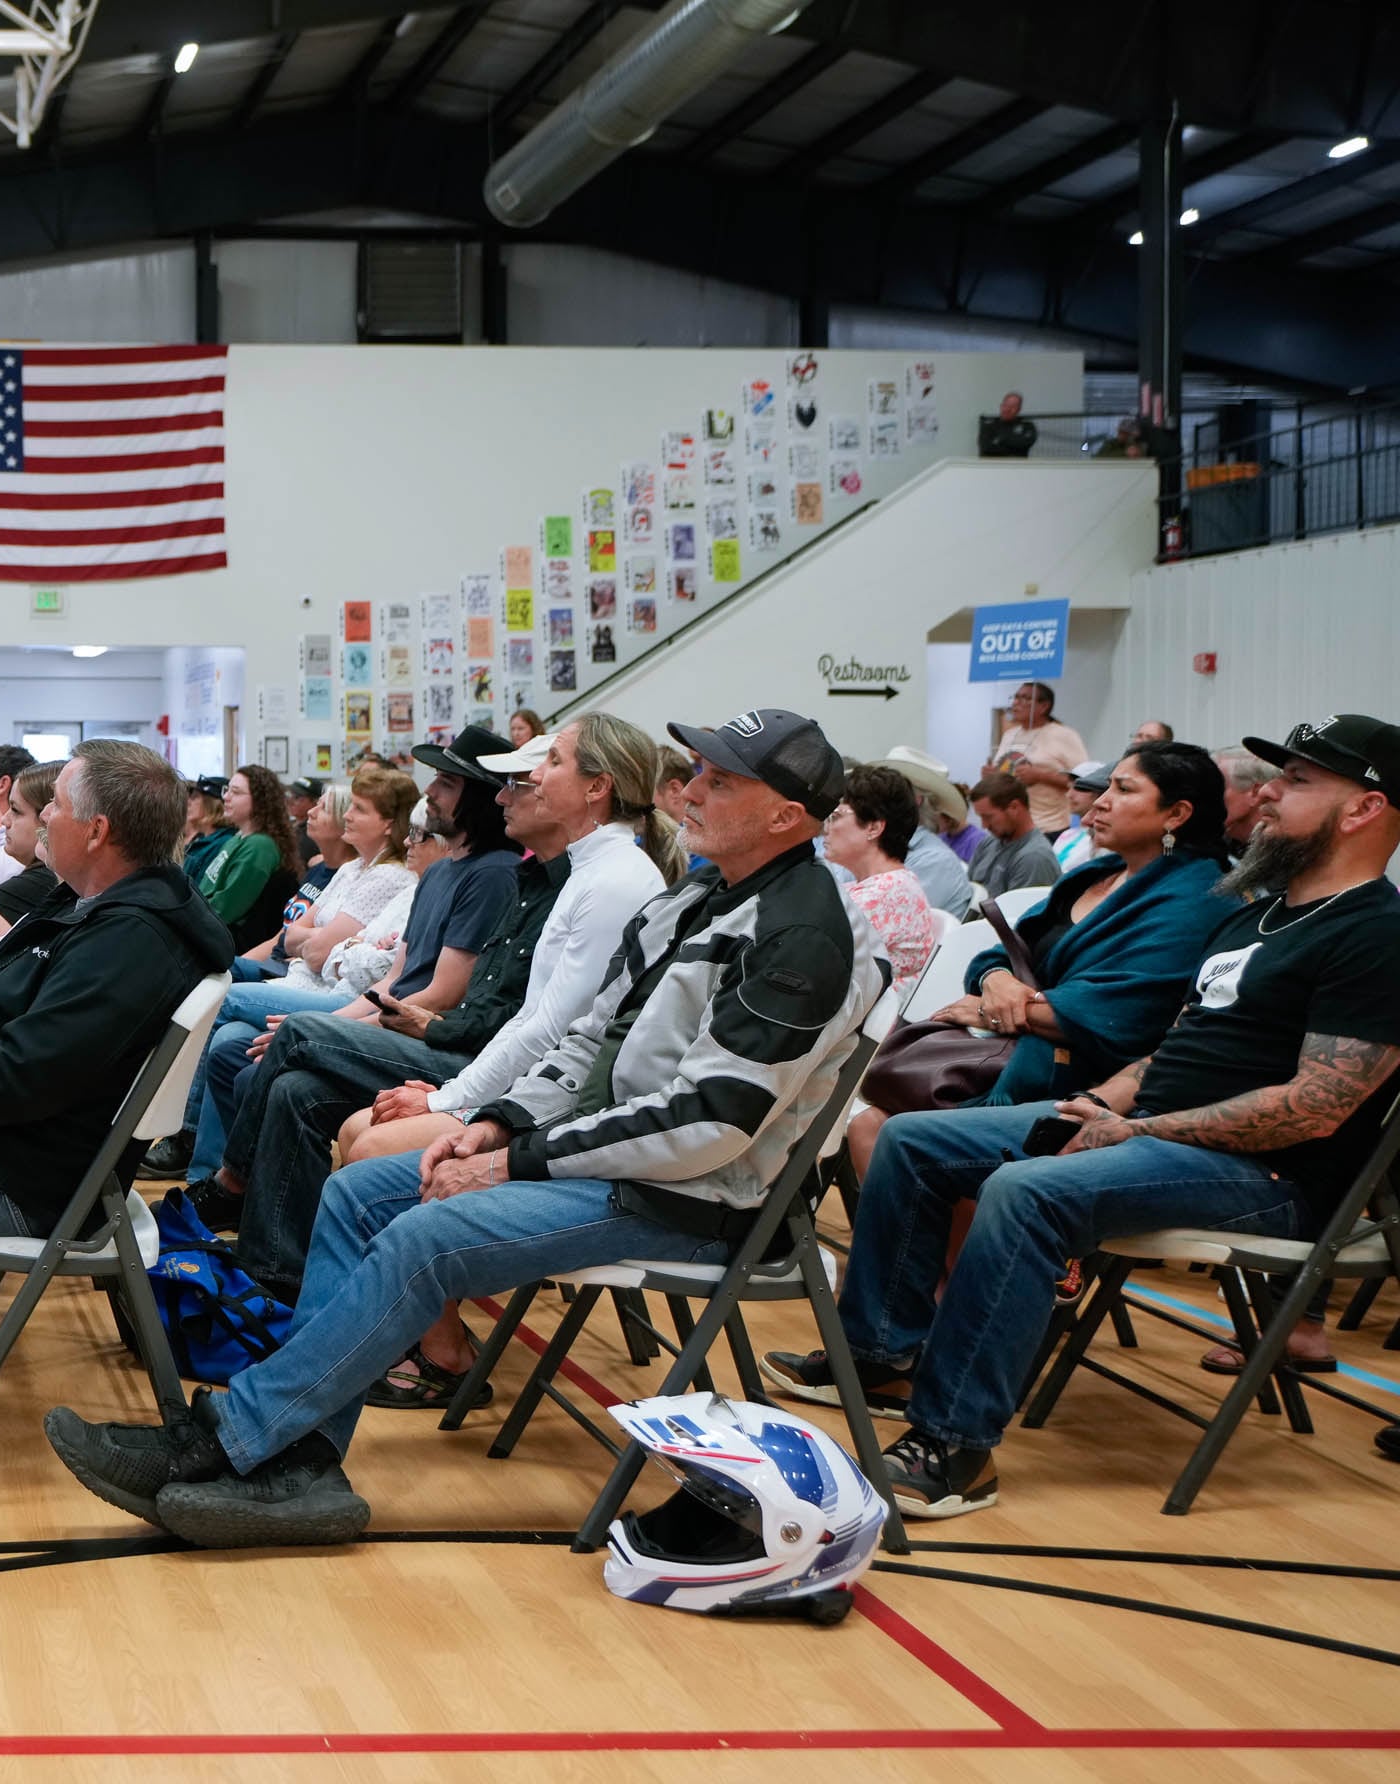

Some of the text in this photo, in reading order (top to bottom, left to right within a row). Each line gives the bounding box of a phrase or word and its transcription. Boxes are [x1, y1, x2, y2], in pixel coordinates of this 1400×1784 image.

[980, 629, 1057, 654] OUT OF
[818, 654, 911, 685] Restrooms
